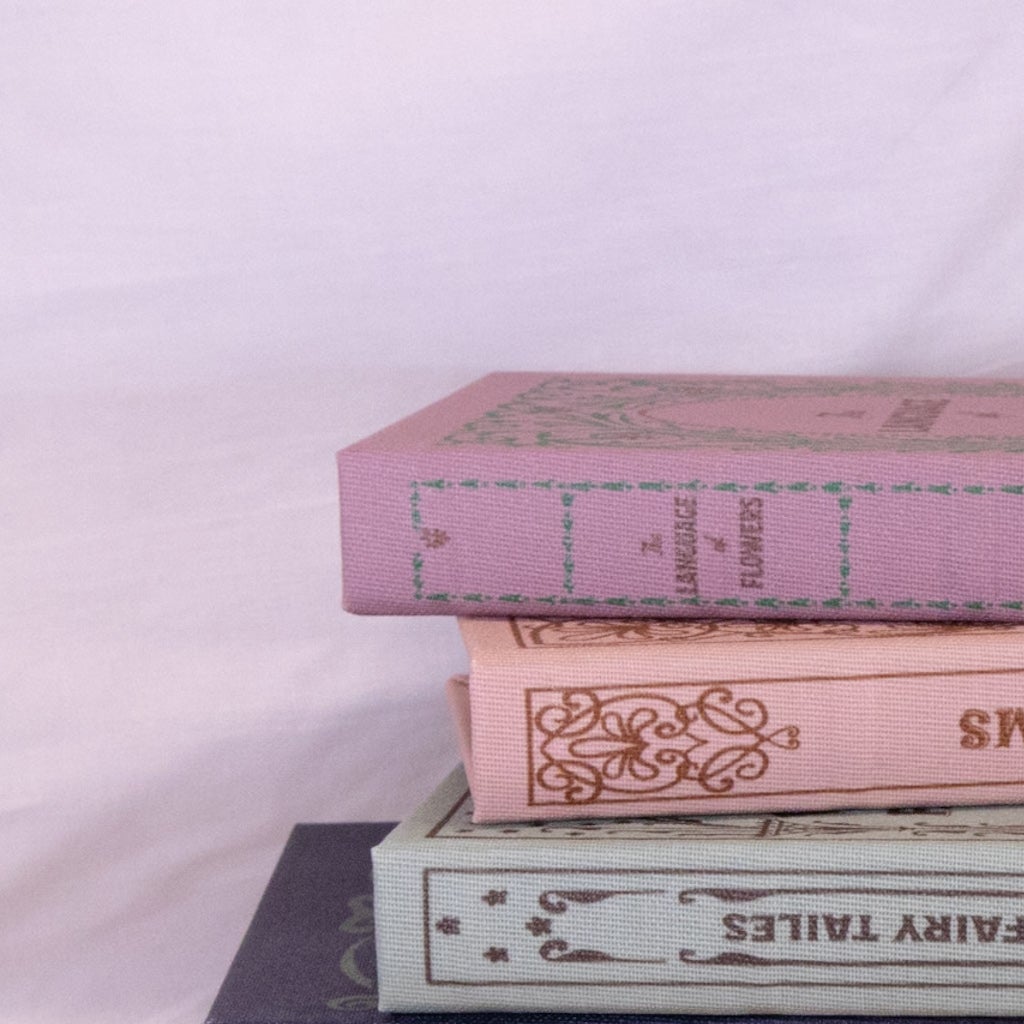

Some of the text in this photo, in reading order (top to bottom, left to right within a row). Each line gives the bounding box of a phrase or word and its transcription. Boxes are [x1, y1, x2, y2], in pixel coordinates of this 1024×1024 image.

[674, 496, 698, 595] LANGUAGE
[739, 497, 764, 590] FLOWERS
[721, 912, 880, 943] TAILES
